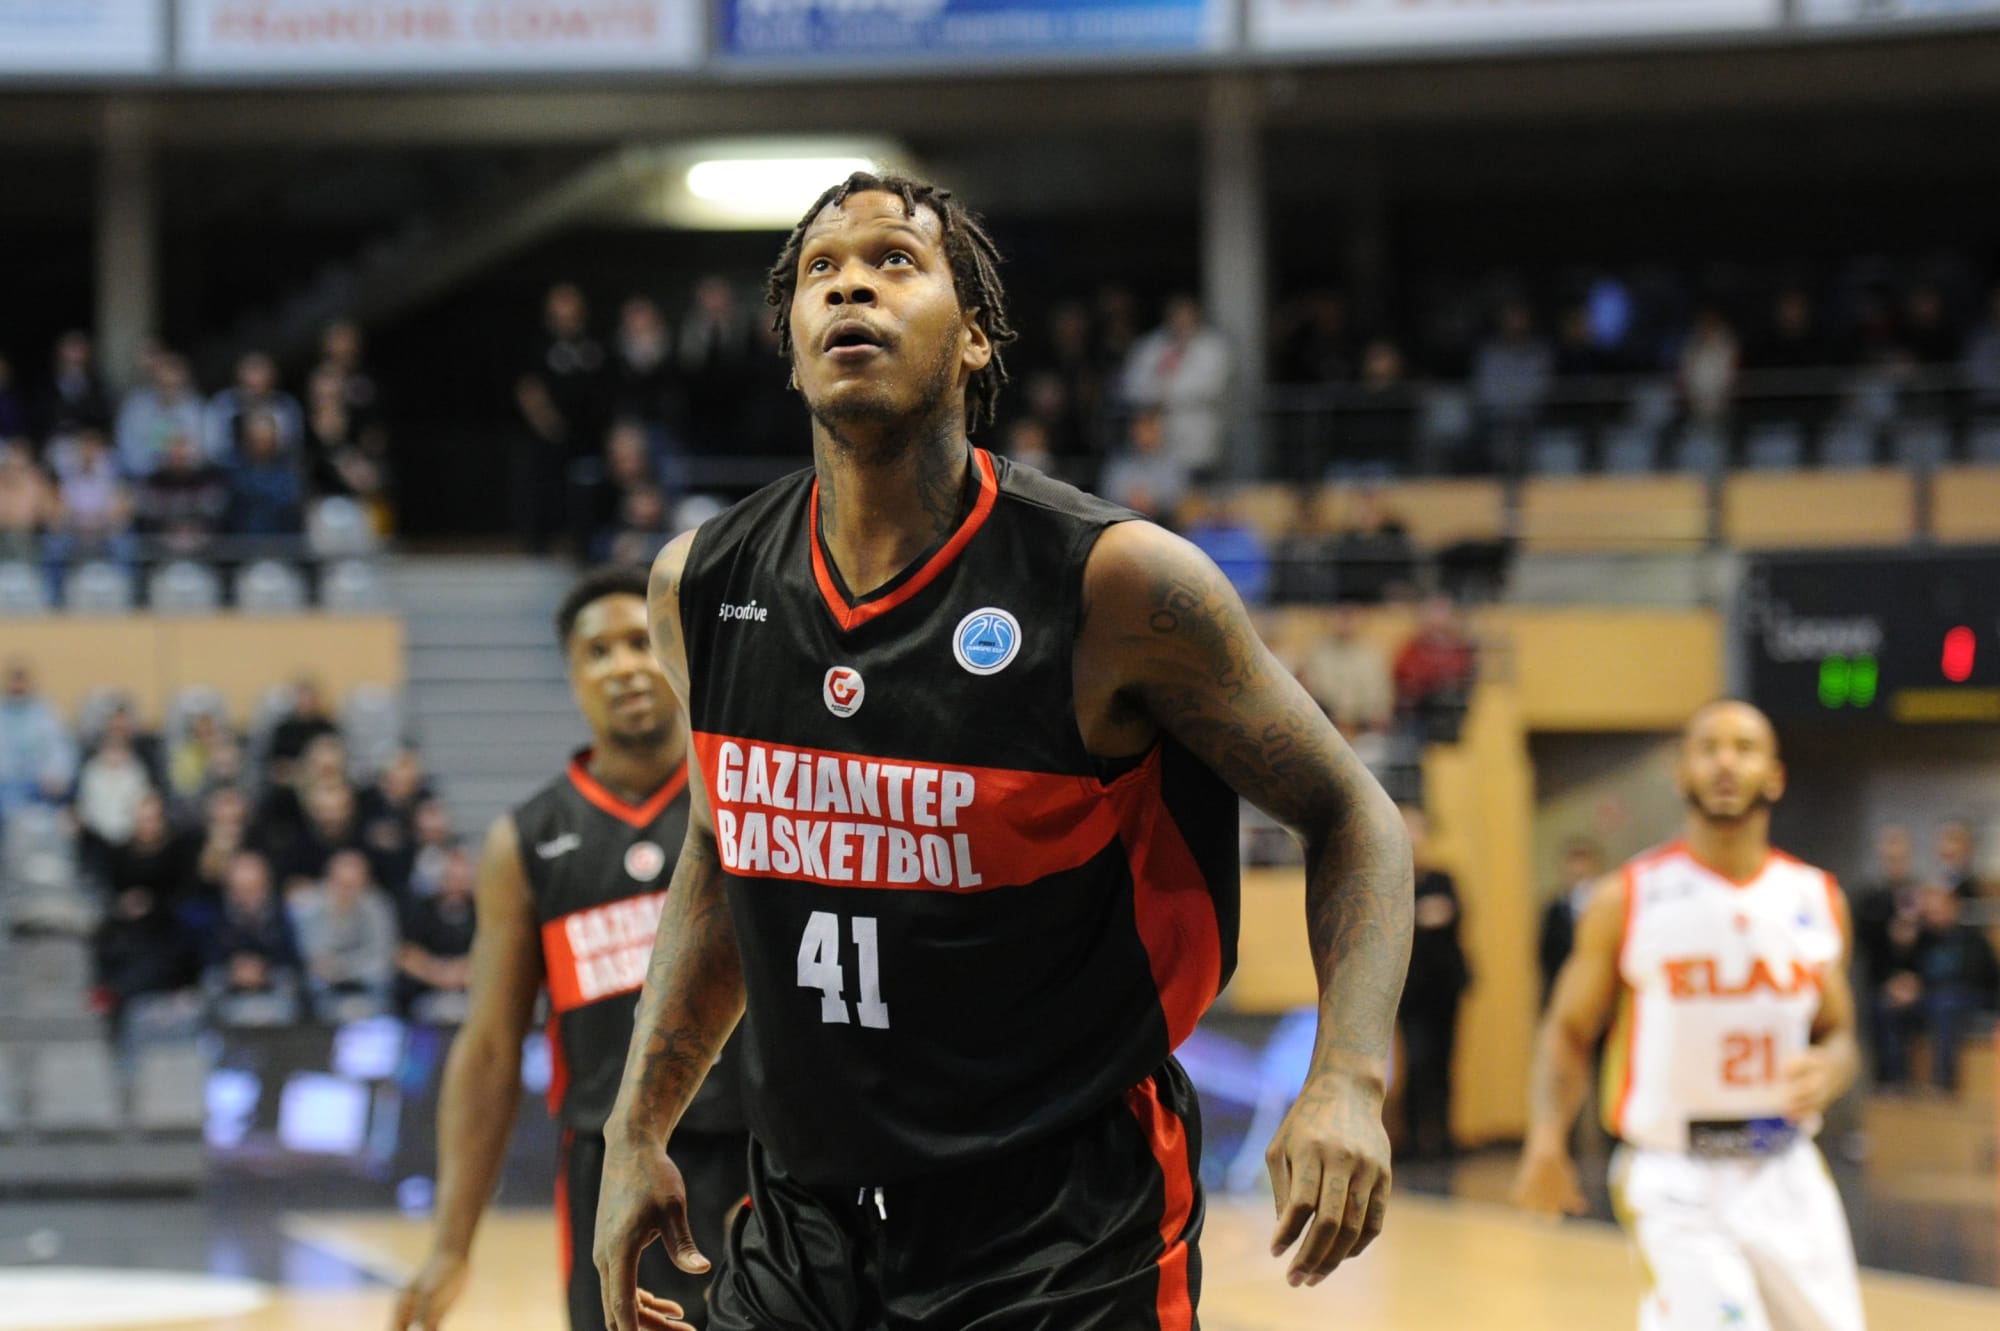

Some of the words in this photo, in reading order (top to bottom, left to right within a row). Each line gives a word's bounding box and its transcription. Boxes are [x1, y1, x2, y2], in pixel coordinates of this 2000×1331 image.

[717, 808, 983, 888] BASKETBOL
[796, 910, 890, 1030] 41
[1721, 1031, 1775, 1087] 21
